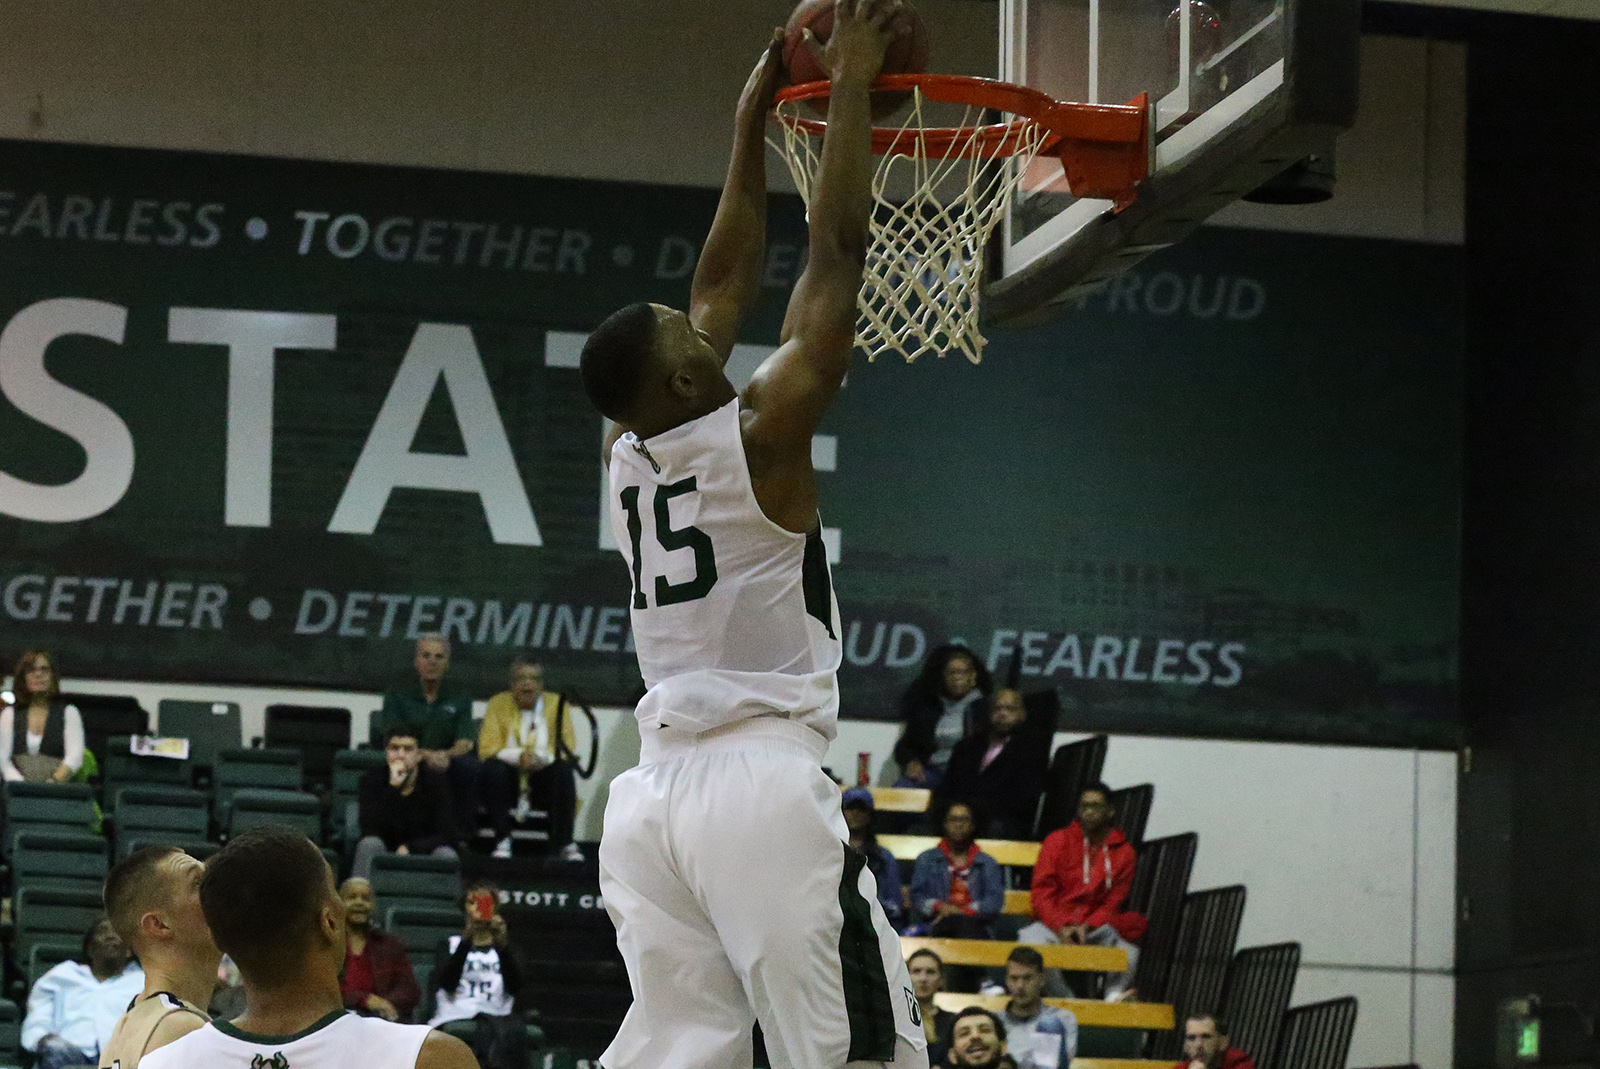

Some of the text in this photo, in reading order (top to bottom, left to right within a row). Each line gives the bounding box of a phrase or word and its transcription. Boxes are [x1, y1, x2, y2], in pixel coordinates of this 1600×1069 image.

[294, 211, 593, 275] TOGETHER
[0, 298, 842, 564] STA
[620, 475, 718, 610] 15
[986, 629, 1246, 687] FEARLESS
[499, 889, 569, 907] STOTT
